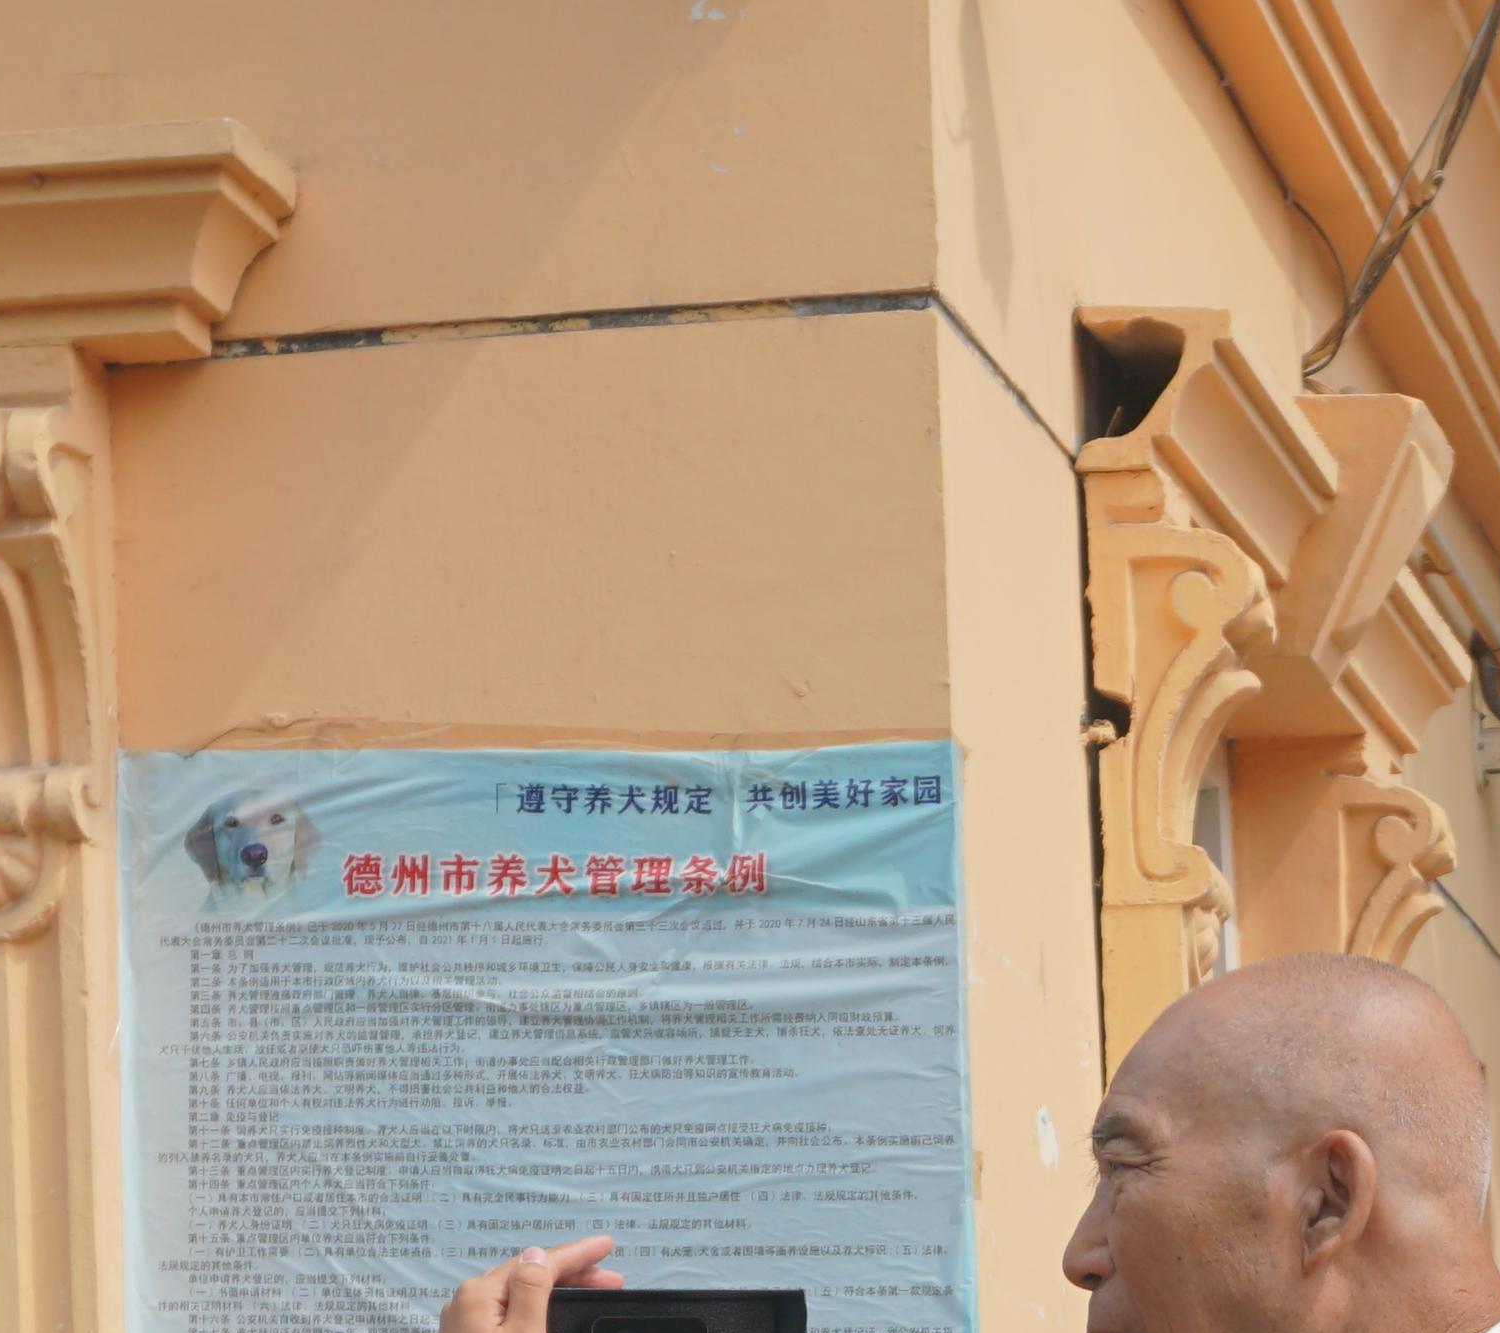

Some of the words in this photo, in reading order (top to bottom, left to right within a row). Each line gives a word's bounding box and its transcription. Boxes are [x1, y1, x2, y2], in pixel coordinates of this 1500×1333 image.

[746, 775, 942, 812] 共创美好家园
[342, 853, 768, 897] 德州市养犬管理条例
